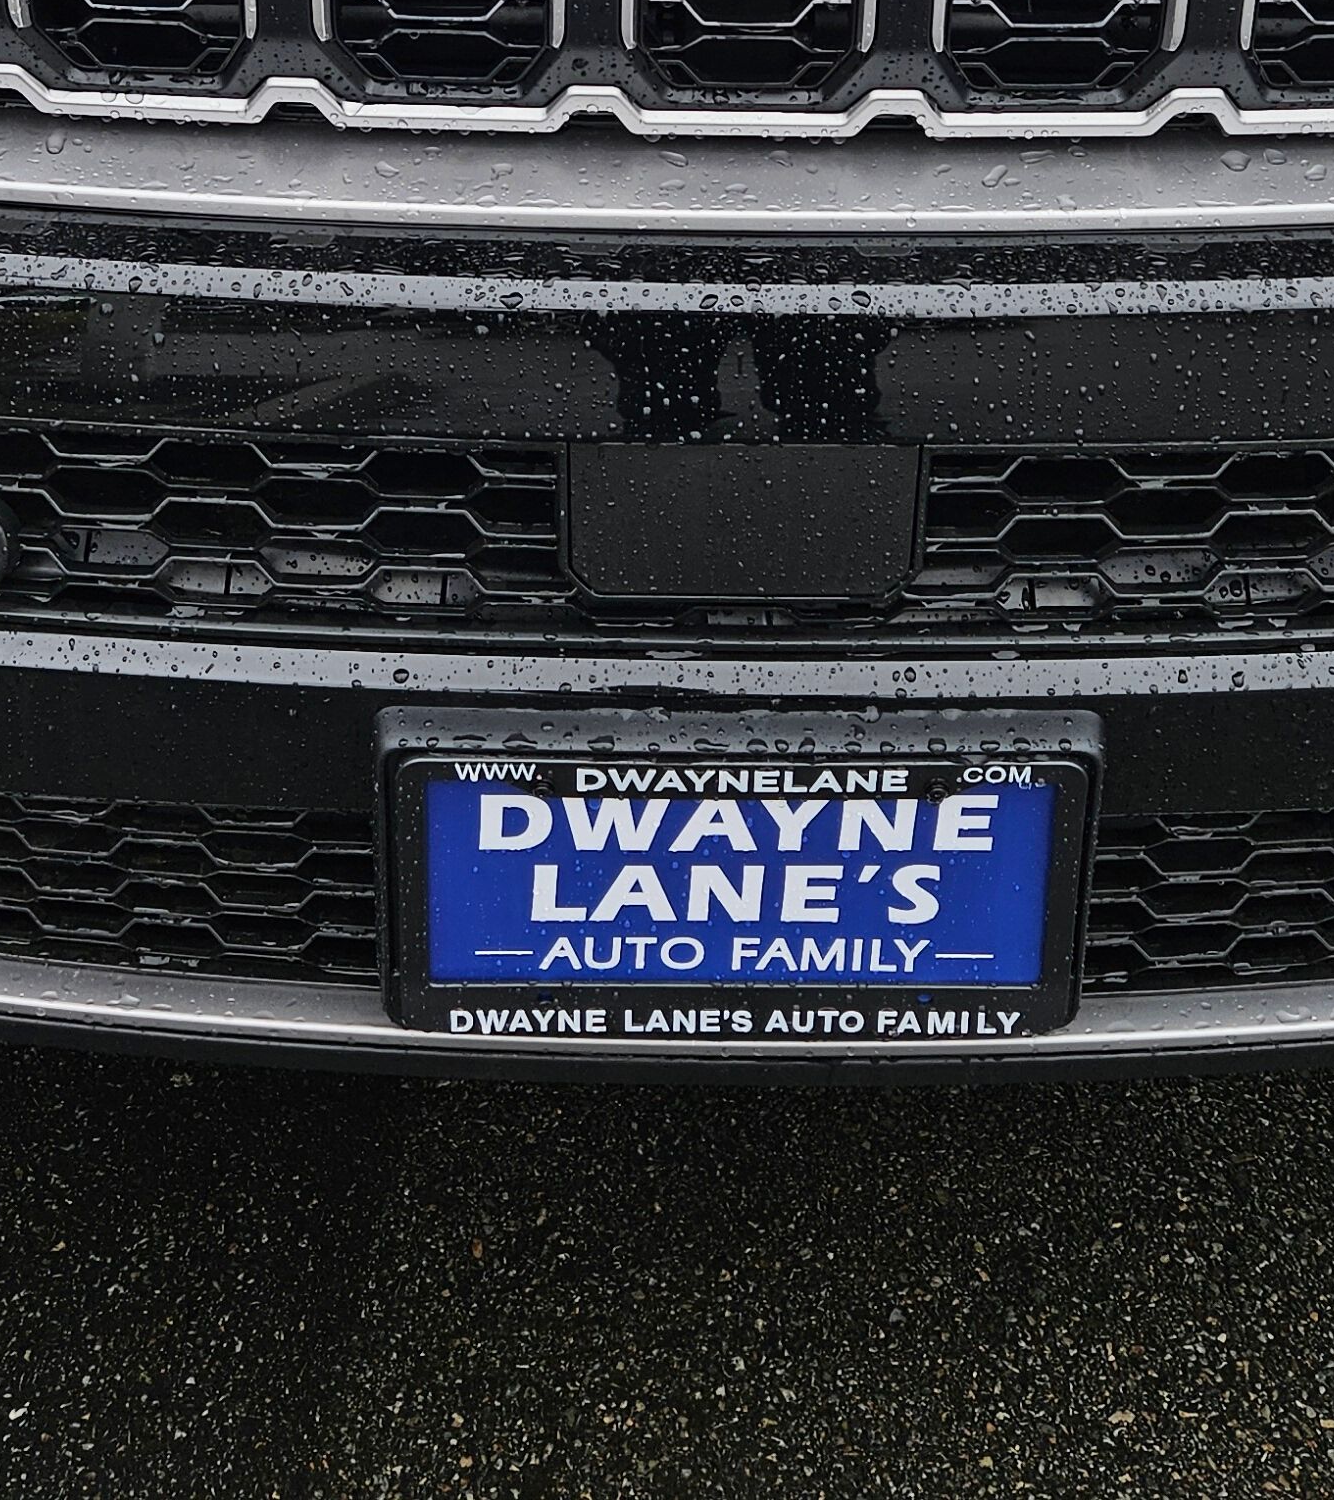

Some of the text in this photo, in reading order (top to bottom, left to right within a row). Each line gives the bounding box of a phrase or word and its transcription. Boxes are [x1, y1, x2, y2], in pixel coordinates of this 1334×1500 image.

[576, 767, 909, 793] DWAYNELANE
[955, 765, 1032, 784] .COM
[478, 793, 1000, 852] DWAYNE
[530, 864, 941, 925] LANE'S
[538, 936, 931, 973] AUTO FAMILY
[449, 1008, 1021, 1036] DWAYNE LANE'S AUTO FAMILY
